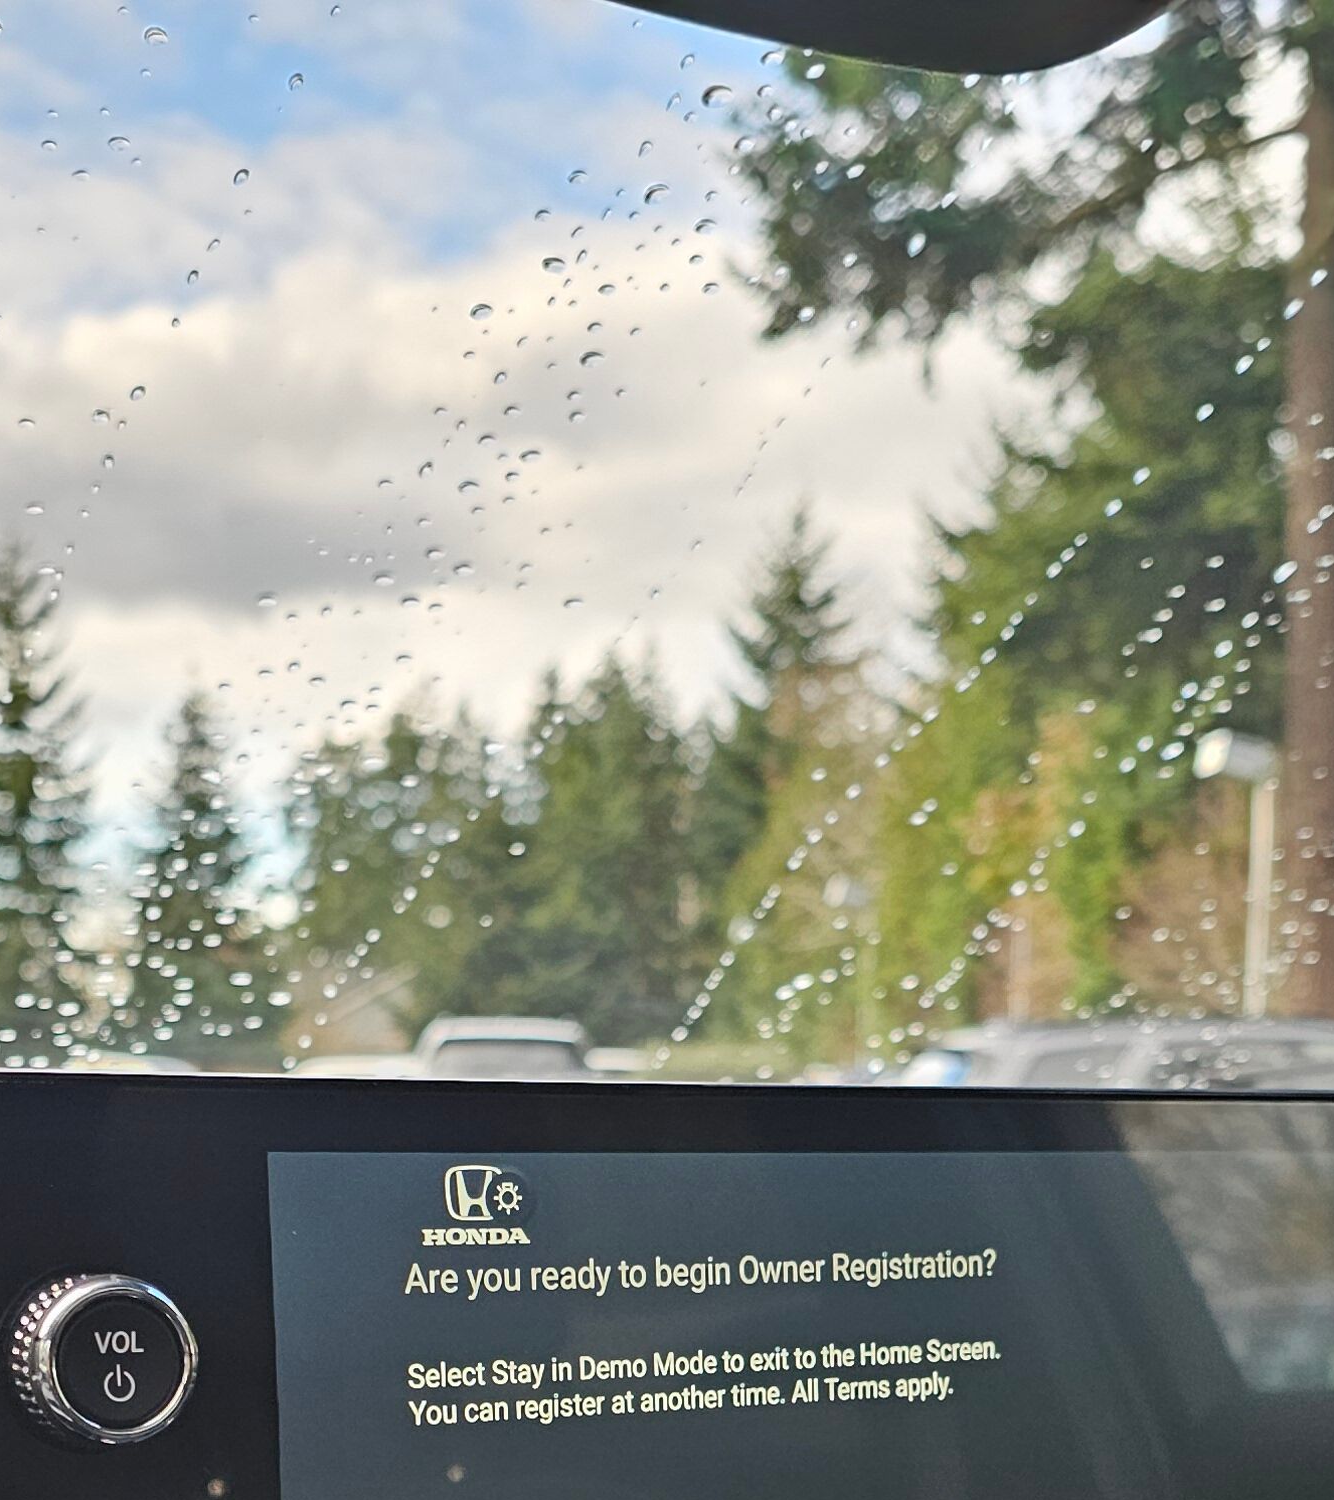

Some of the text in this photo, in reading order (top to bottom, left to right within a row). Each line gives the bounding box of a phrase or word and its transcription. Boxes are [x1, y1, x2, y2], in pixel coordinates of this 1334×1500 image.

[421, 1226, 531, 1246] HONDA
[404, 1247, 998, 1301] Are you ready to begin Owner Registration?
[94, 1330, 145, 1354] VOL
[407, 1338, 1002, 1390] Select Stay in Demo Mode to exit to the Home Screen.
[407, 1370, 954, 1427] You can register at another time. All Terms apply.
